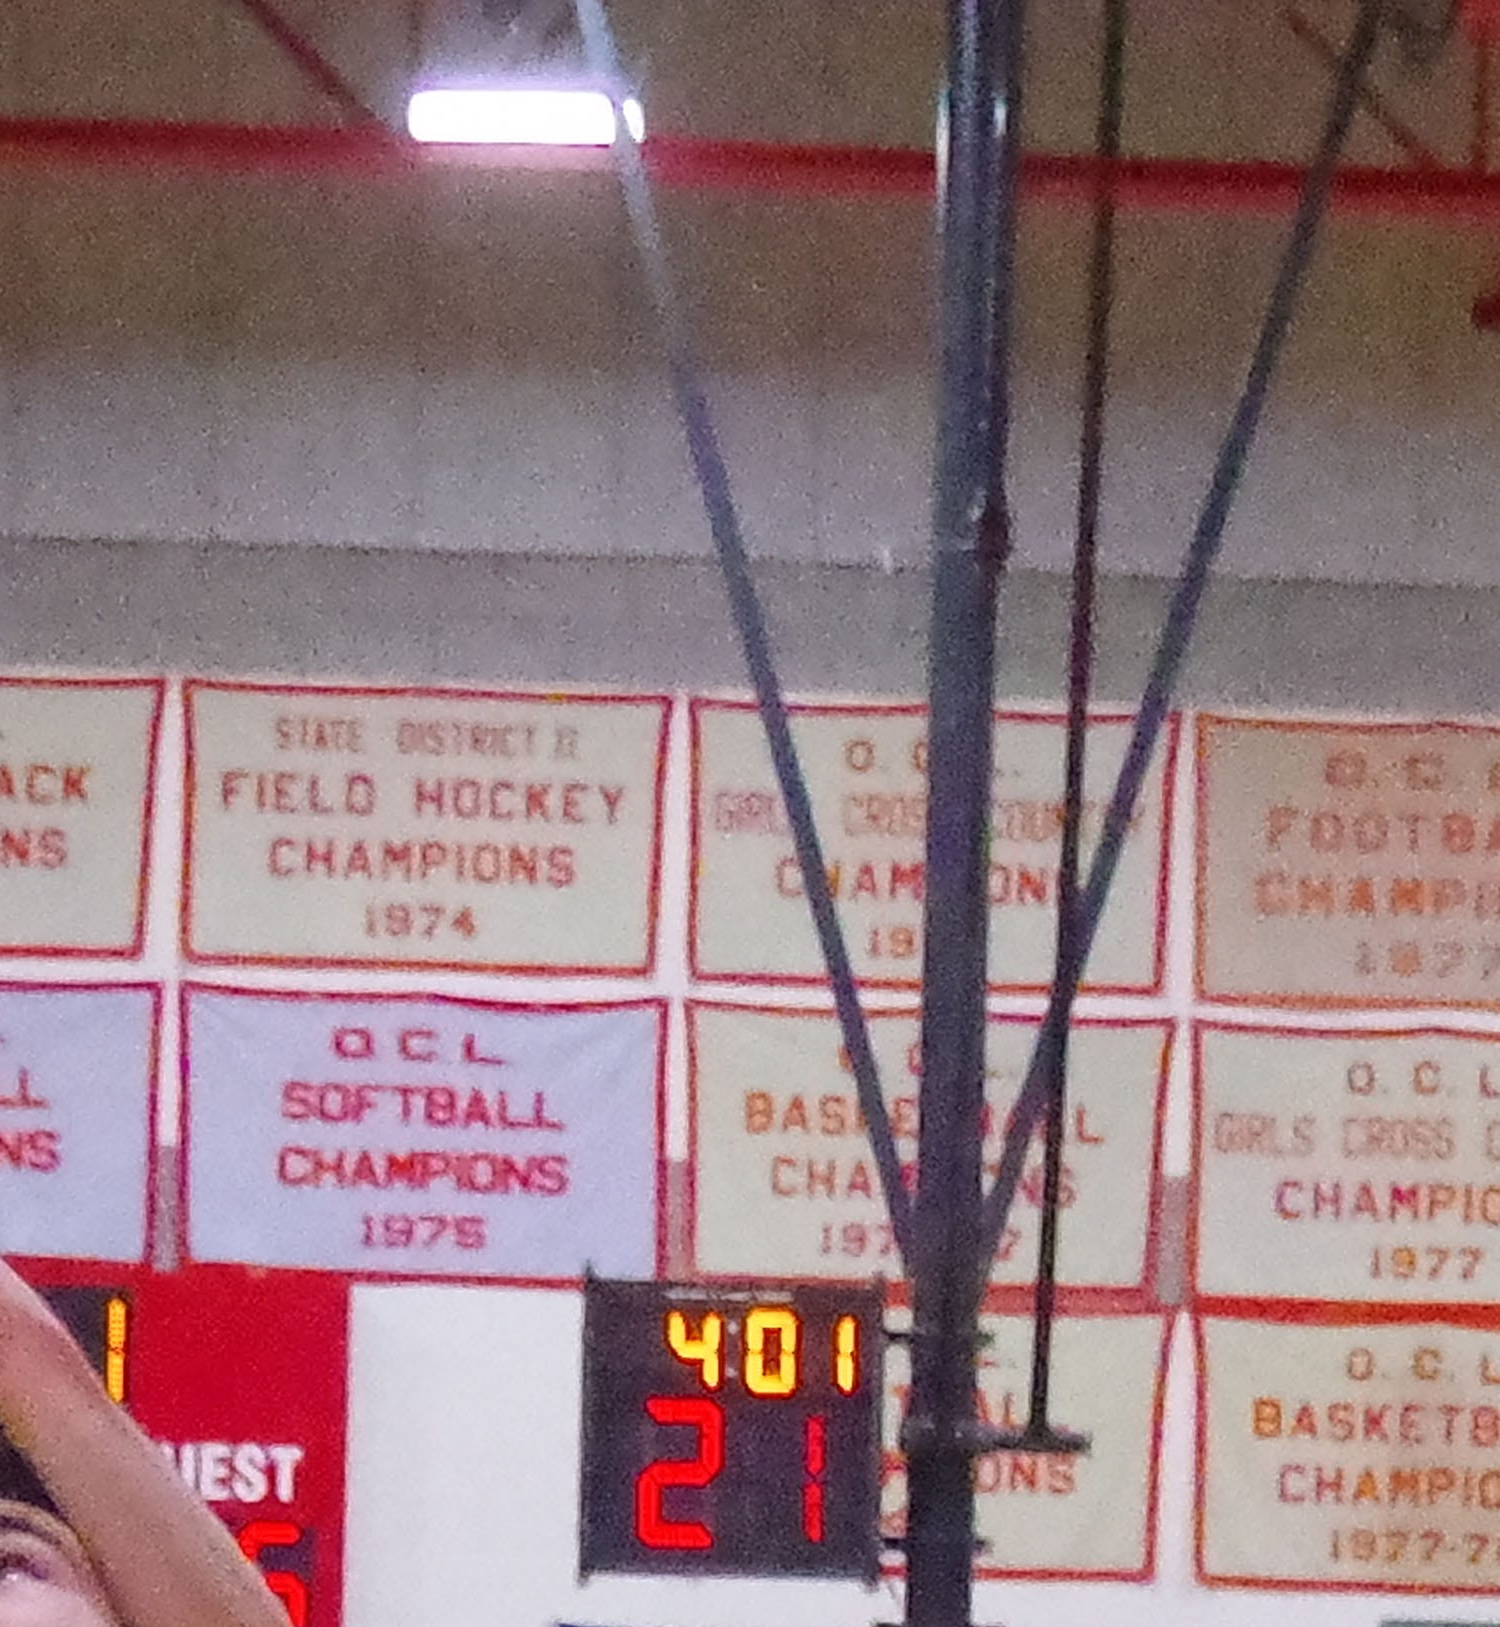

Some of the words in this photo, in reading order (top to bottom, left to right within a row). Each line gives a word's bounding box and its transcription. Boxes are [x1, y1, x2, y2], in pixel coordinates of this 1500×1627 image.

[273, 716, 363, 752] STATE
[397, 720, 536, 758] DISTRICT
[220, 769, 377, 817] FIELD
[412, 776, 626, 826] HOCKEY
[266, 836, 577, 889] CHAMPIONS
[1254, 870, 1500, 917] CHAMPI
[364, 903, 480, 941] 1974
[281, 1080, 564, 1132] SOFTBALL
[276, 1145, 571, 1197] CHAMPIONS
[360, 1213, 487, 1252] 1975
[1369, 1247, 1485, 1280] 1977
[1330, 1527, 1500, 1565] 1977-7
